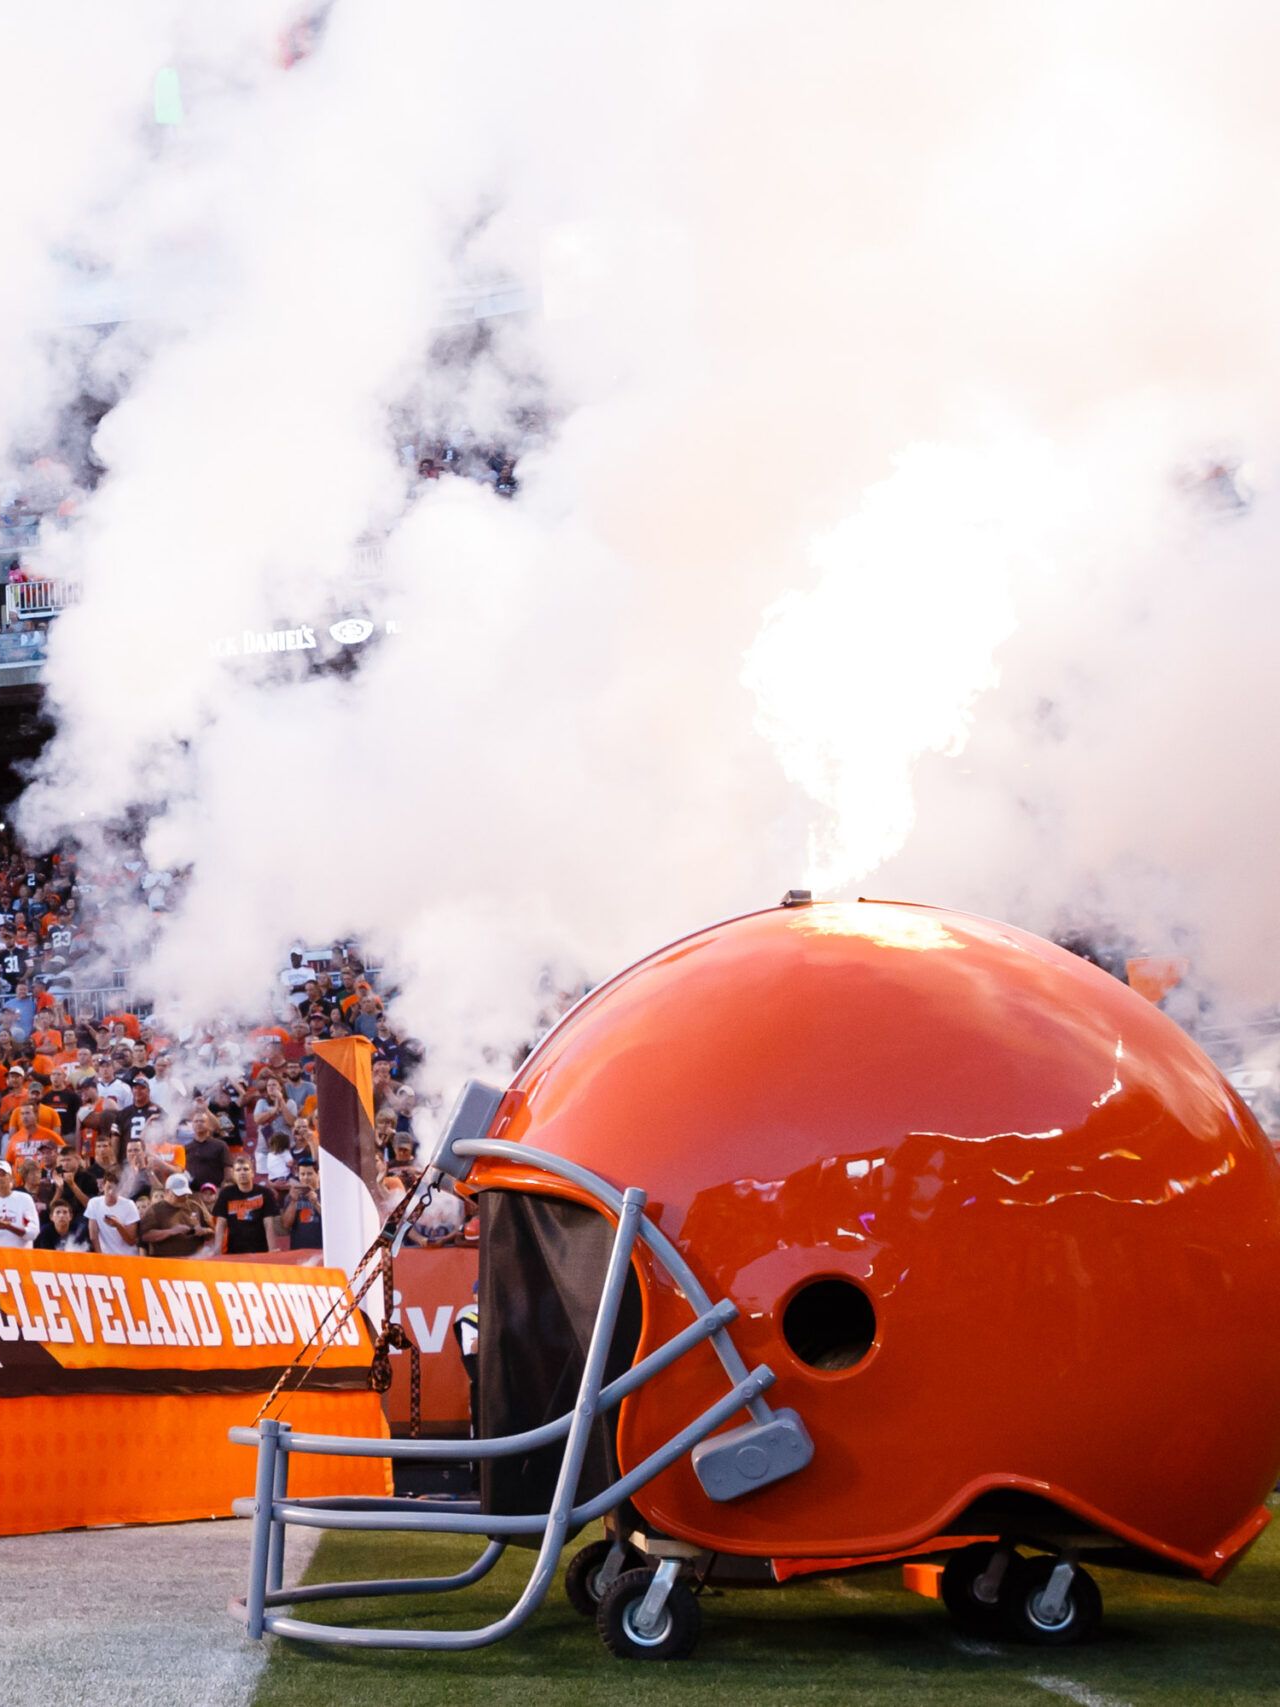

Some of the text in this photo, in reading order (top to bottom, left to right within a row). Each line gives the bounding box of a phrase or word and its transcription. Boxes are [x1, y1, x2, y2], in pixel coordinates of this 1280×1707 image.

[51, 931, 72, 947] 23
[3, 955, 20, 973] 31
[130, 1116, 146, 1139] 2
[216, 1281, 361, 1347] BROWNS
